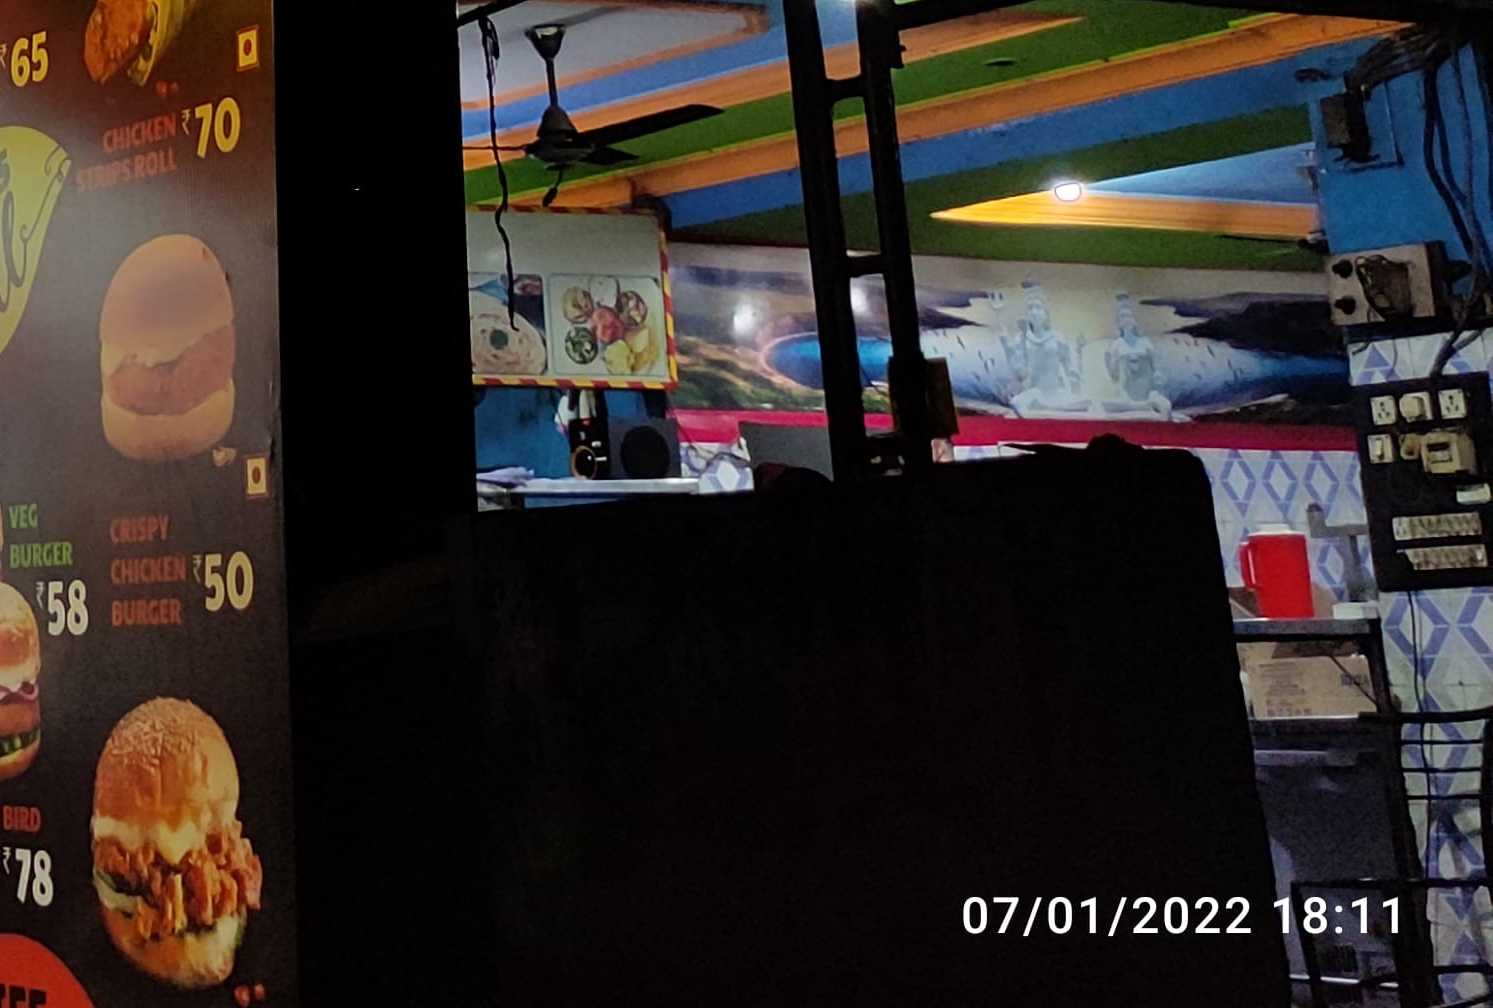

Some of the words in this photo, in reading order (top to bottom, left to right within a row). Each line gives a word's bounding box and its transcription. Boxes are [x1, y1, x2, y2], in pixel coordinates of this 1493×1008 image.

[102, 112, 177, 154] CHICKEN
[133, 146, 178, 179] ROLL
[9, 503, 38, 530] VEG
[110, 517, 170, 542] CRISPY
[10, 542, 73, 570] BURGER
[110, 554, 186, 583] CHICKEN
[111, 597, 182, 628] BURGER
[2, 804, 42, 834] BIRD
